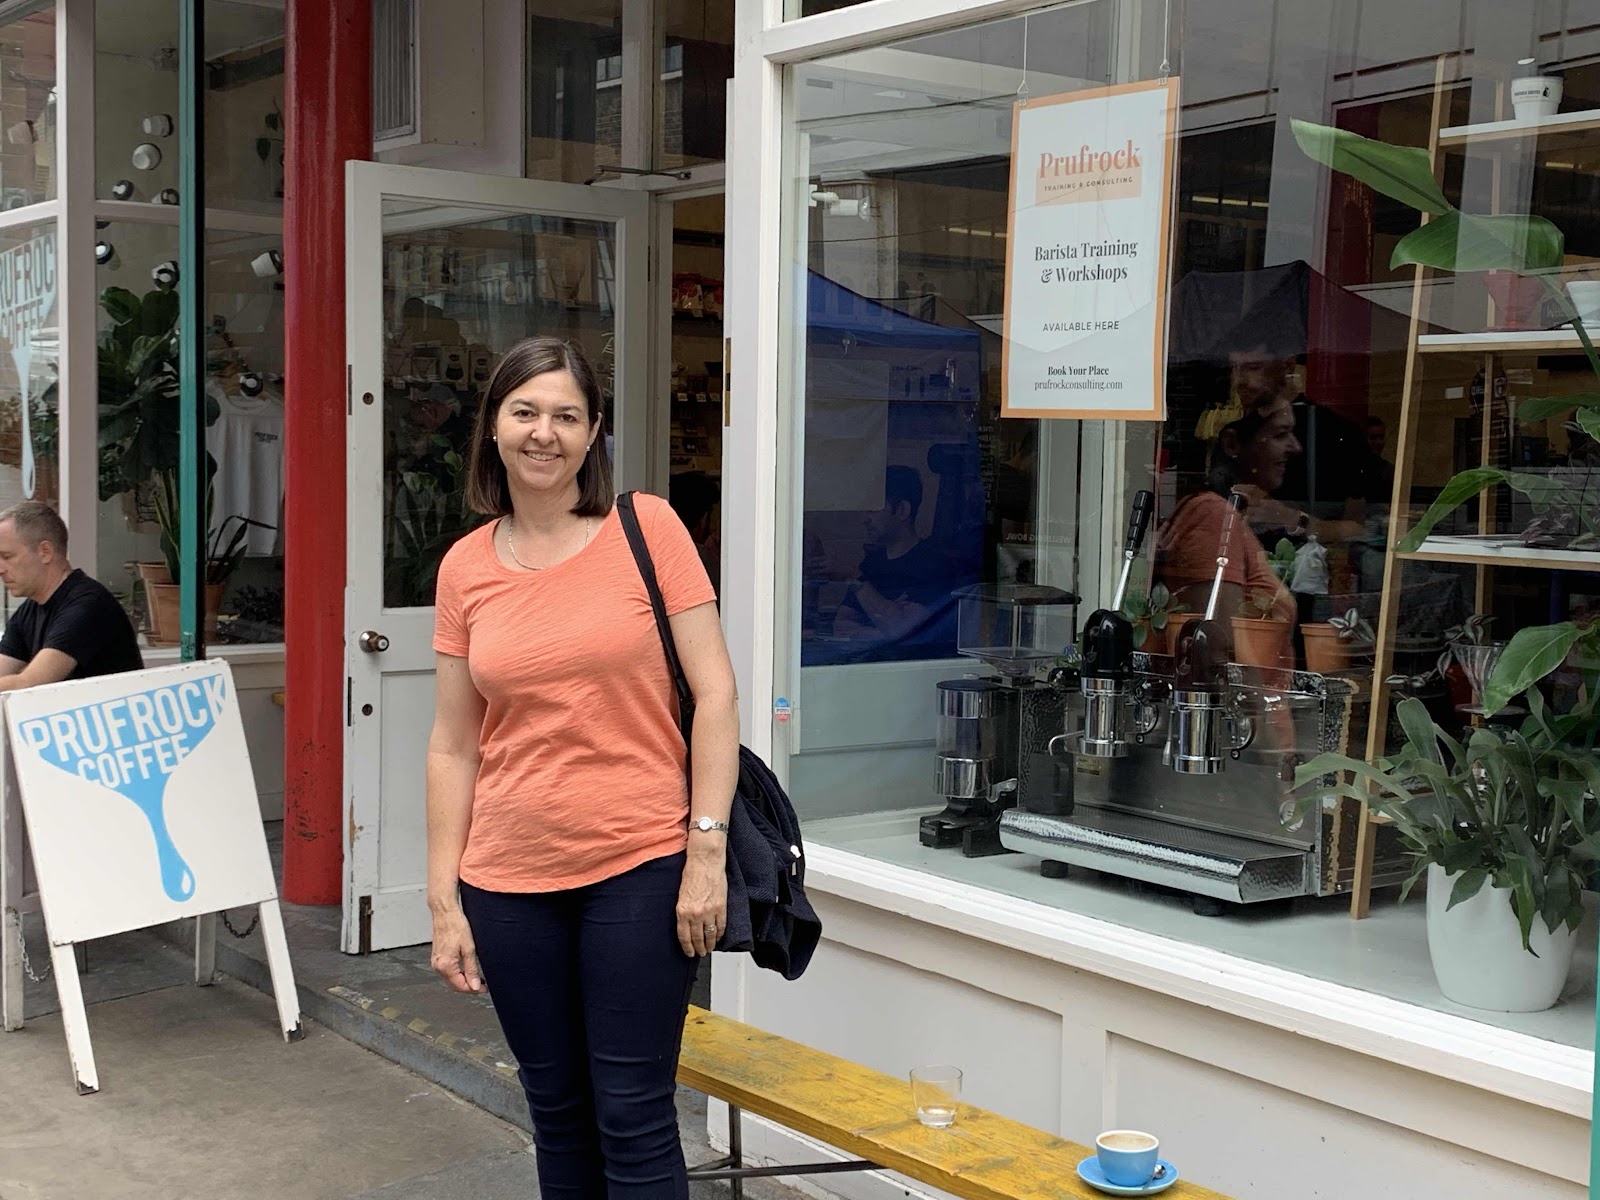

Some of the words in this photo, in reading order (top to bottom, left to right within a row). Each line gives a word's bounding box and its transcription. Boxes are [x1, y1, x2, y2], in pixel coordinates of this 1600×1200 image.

[1039, 139, 1141, 178] Prufrock
[1044, 183, 1076, 192] TRAINING
[1086, 176, 1133, 187] CONSULTING
[1035, 244, 1078, 261] Barista
[1081, 239, 1138, 258] Training
[1041, 268, 1054, 283] &
[1056, 264, 1128, 283] Workshops
[1042, 321, 1092, 331] AVAILABLE
[1095, 320, 1119, 330] HERE
[1048, 365, 1067, 375] Book
[1069, 366, 1087, 375] Your
[1089, 365, 1109, 375] Place
[1034, 379, 1123, 391] prufrockconsulting.com
[22, 675, 226, 762] PRUFROCK
[77, 732, 189, 789] COFFEE
